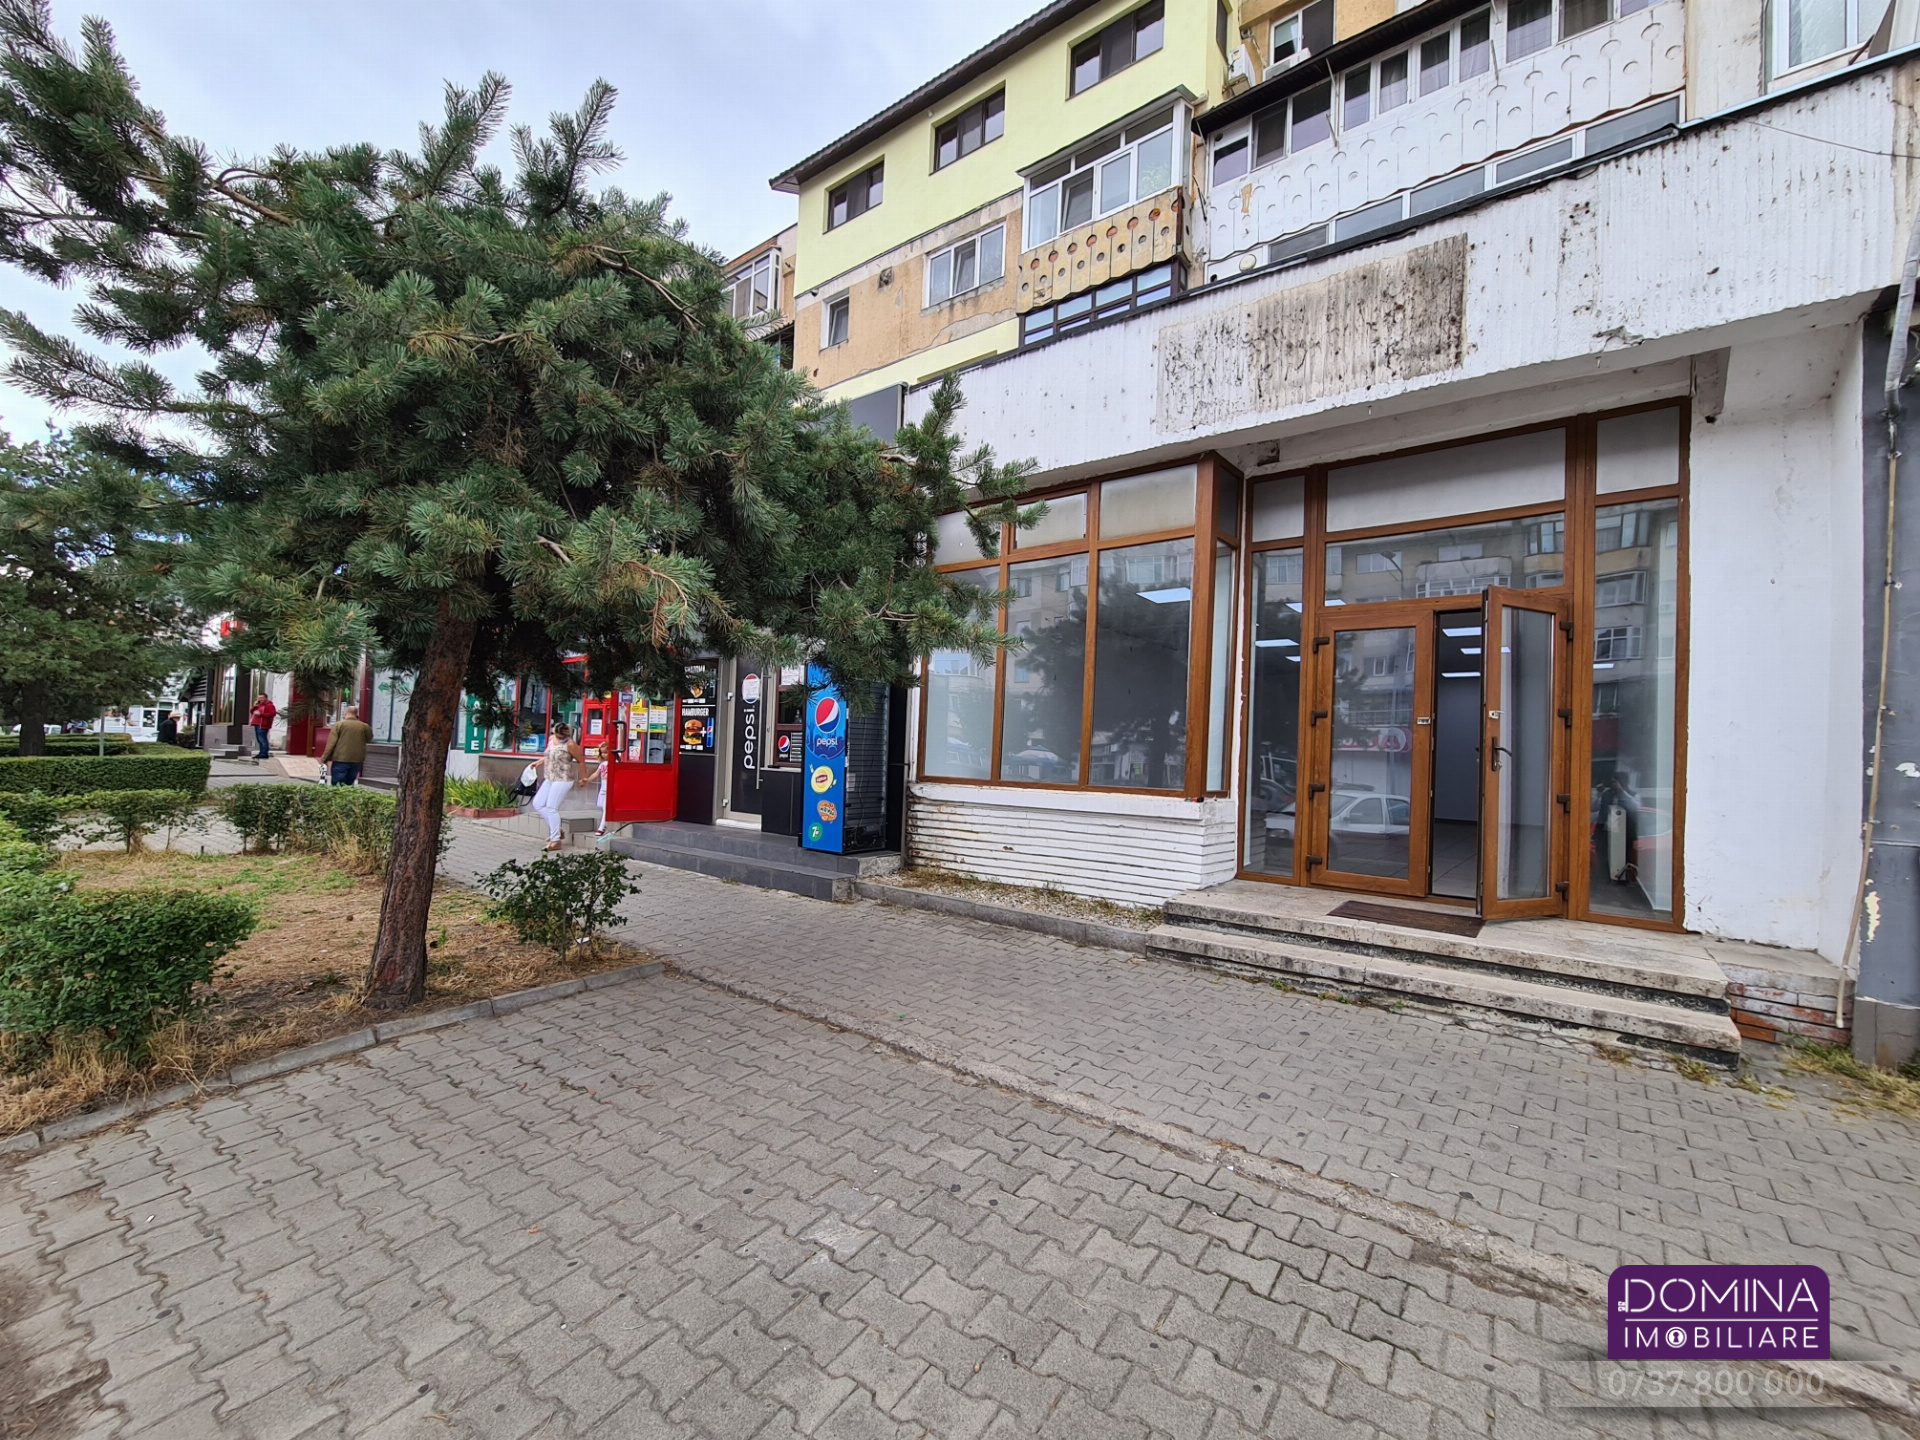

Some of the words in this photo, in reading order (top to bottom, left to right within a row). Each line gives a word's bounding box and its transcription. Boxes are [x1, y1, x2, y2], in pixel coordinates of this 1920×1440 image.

[681, 707, 710, 717] HAMBURGER
[743, 707, 757, 769] pepsi
[816, 737, 838, 747] pepsi
